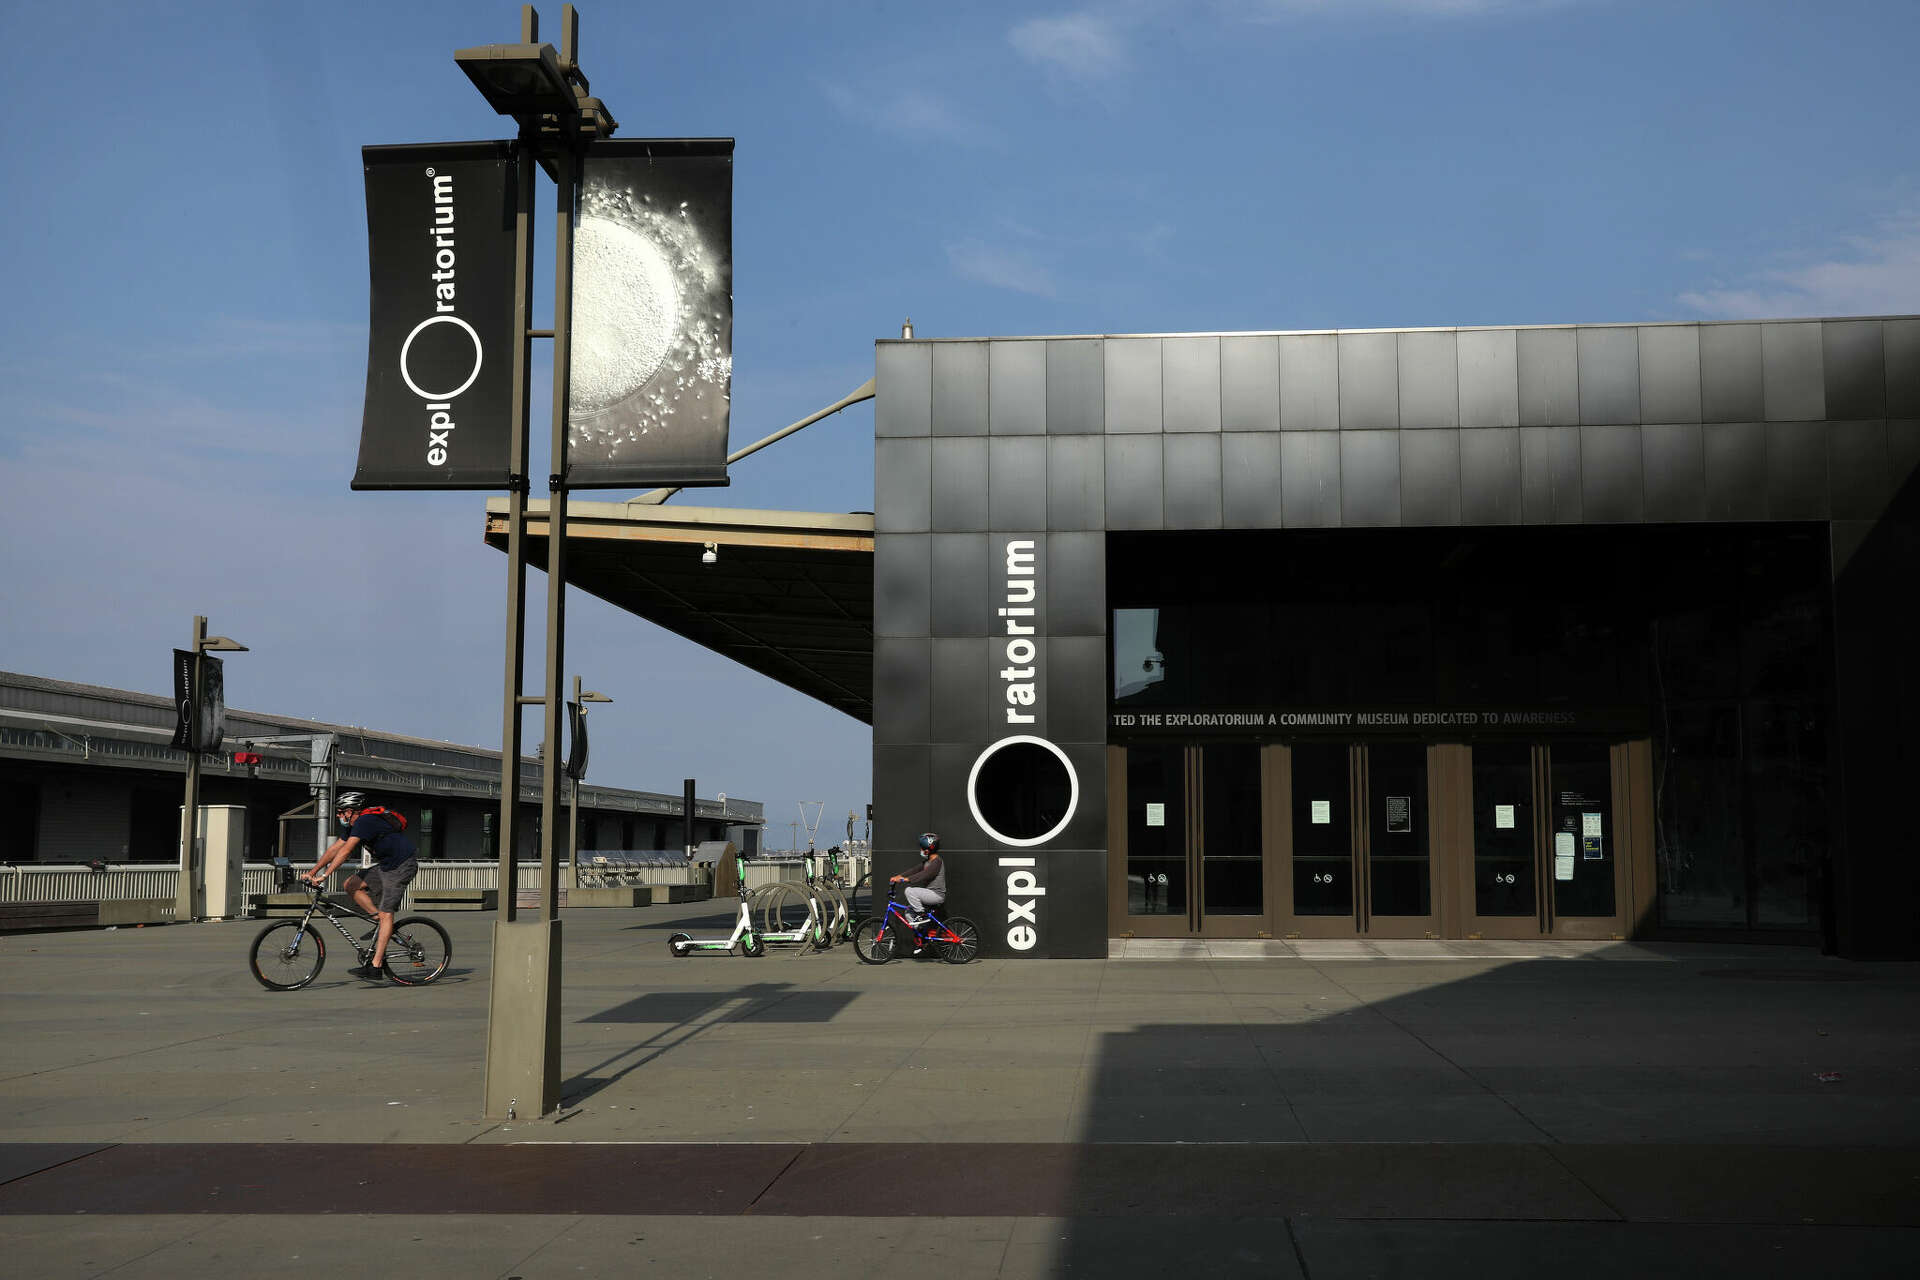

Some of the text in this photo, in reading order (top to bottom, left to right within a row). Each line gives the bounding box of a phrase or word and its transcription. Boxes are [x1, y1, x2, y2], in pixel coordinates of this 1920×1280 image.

[1113, 712, 1577, 726] TED THE EXPLORATORIUM A COMMUNITY MUSEUM DEDICATED TO AWARENESS
